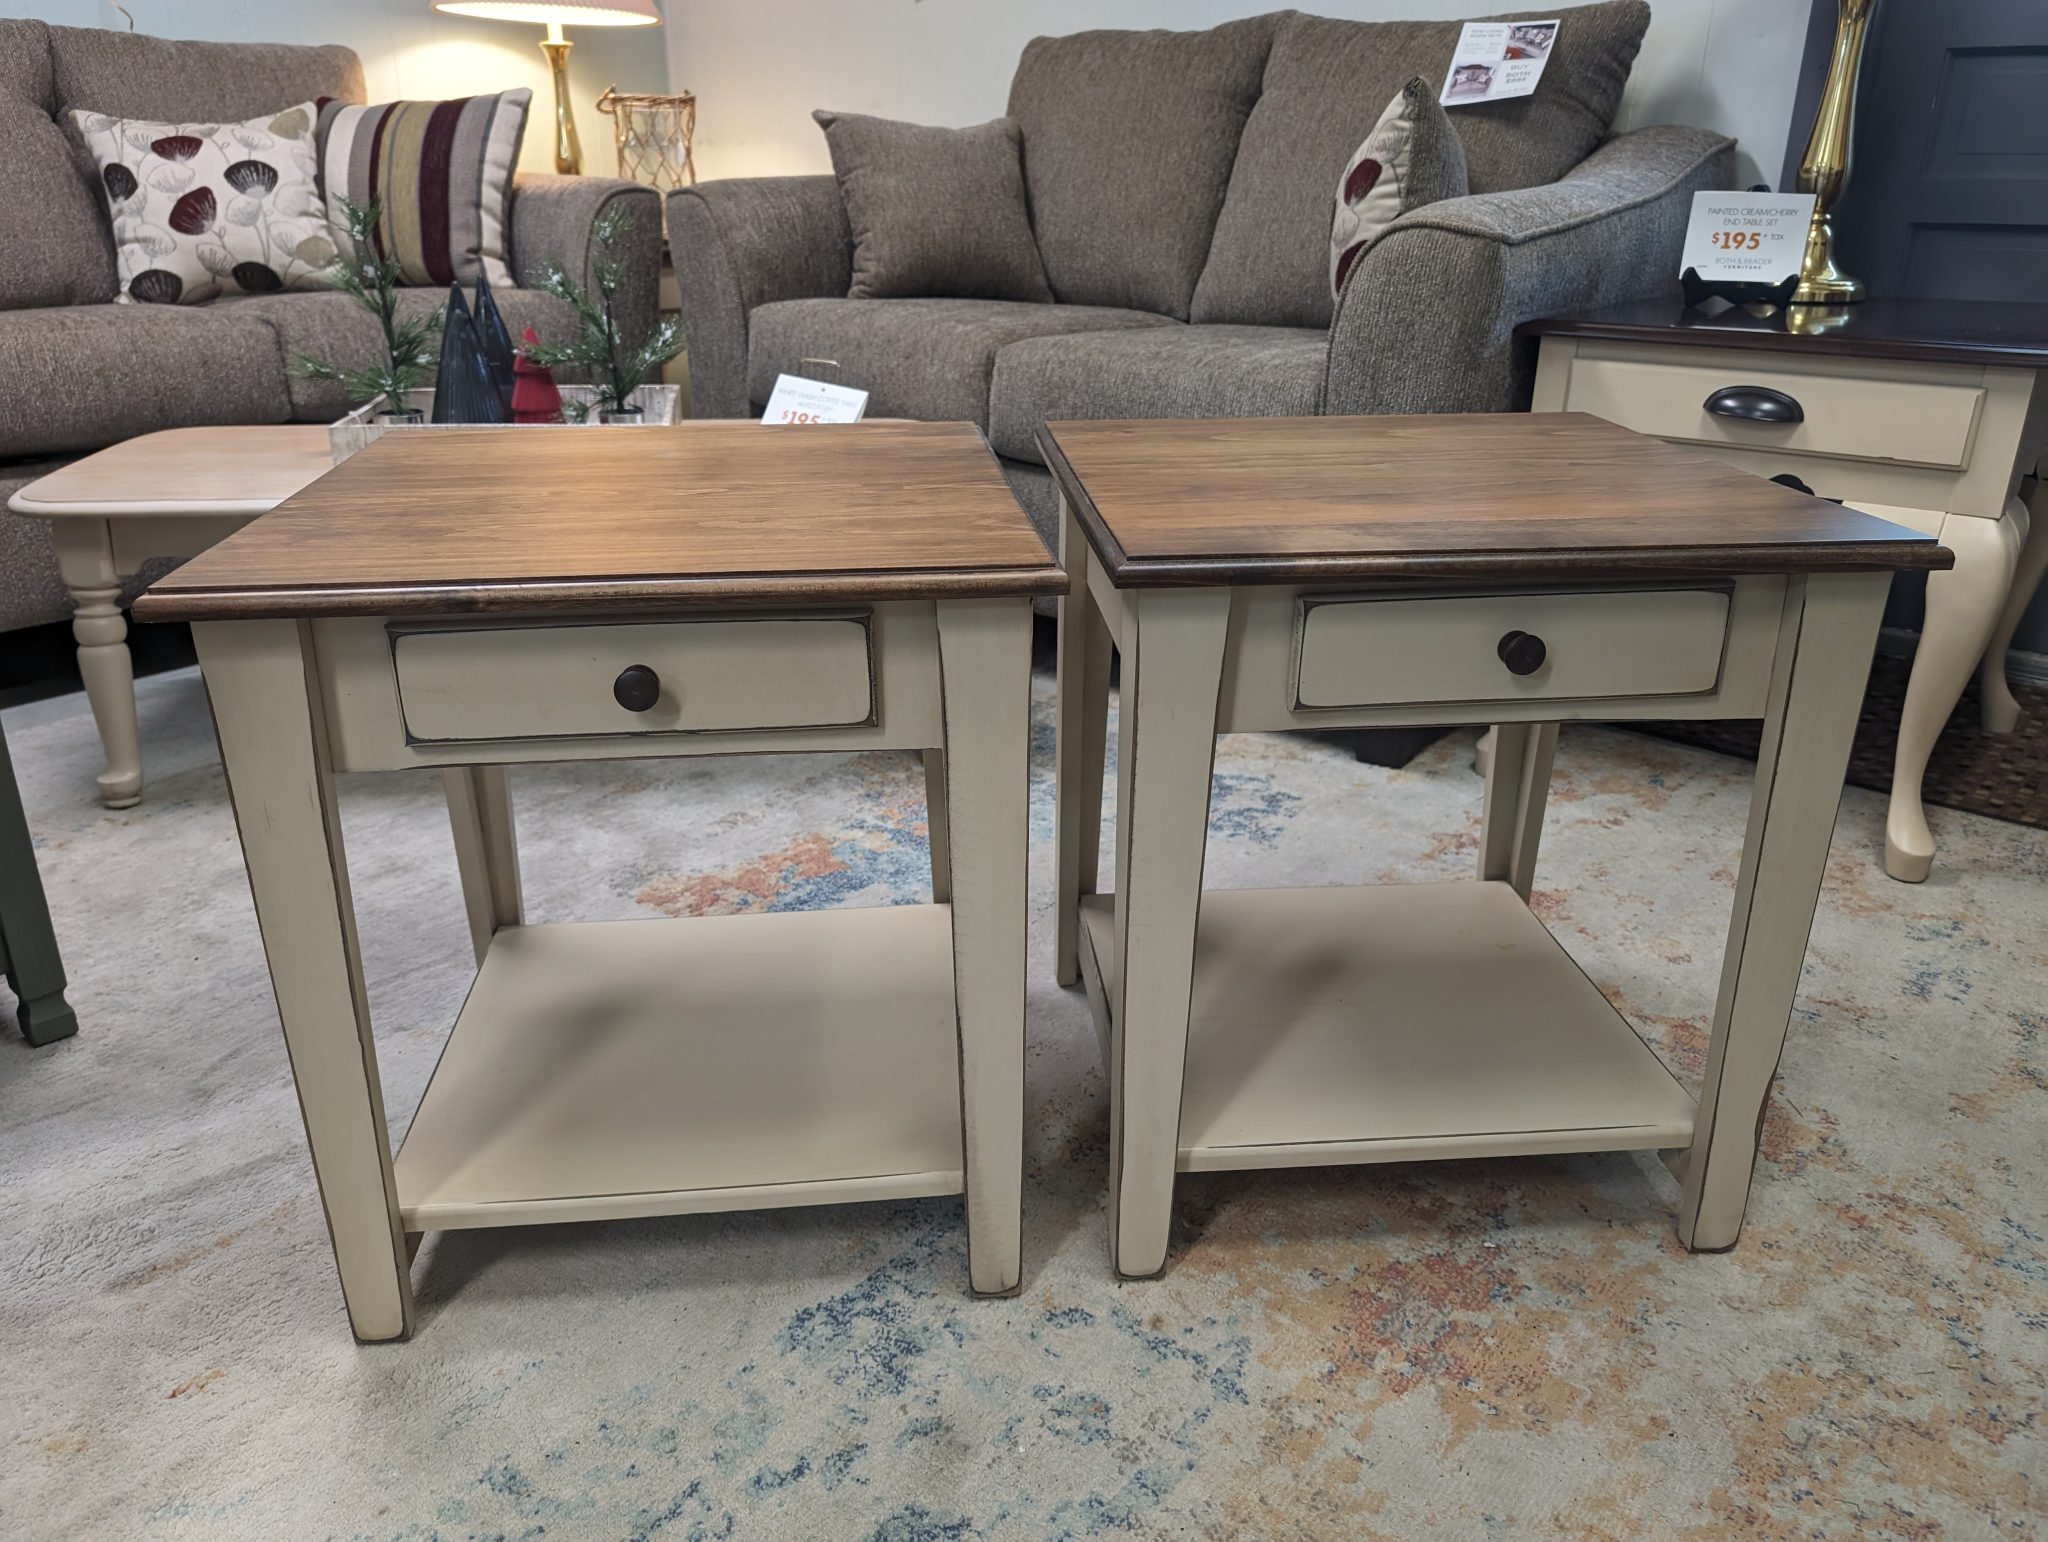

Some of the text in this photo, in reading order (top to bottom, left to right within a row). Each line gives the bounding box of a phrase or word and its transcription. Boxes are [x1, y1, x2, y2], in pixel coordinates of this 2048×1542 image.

[1505, 71, 1532, 79] BOTH
[1707, 207, 1739, 216] PAINTED
[1723, 218, 1779, 227] END TABLE SET
[1711, 231, 1761, 251] $195
[1770, 233, 1785, 241] tax
[1715, 257, 1736, 265] ROTH
[1736, 257, 1743, 265] &
